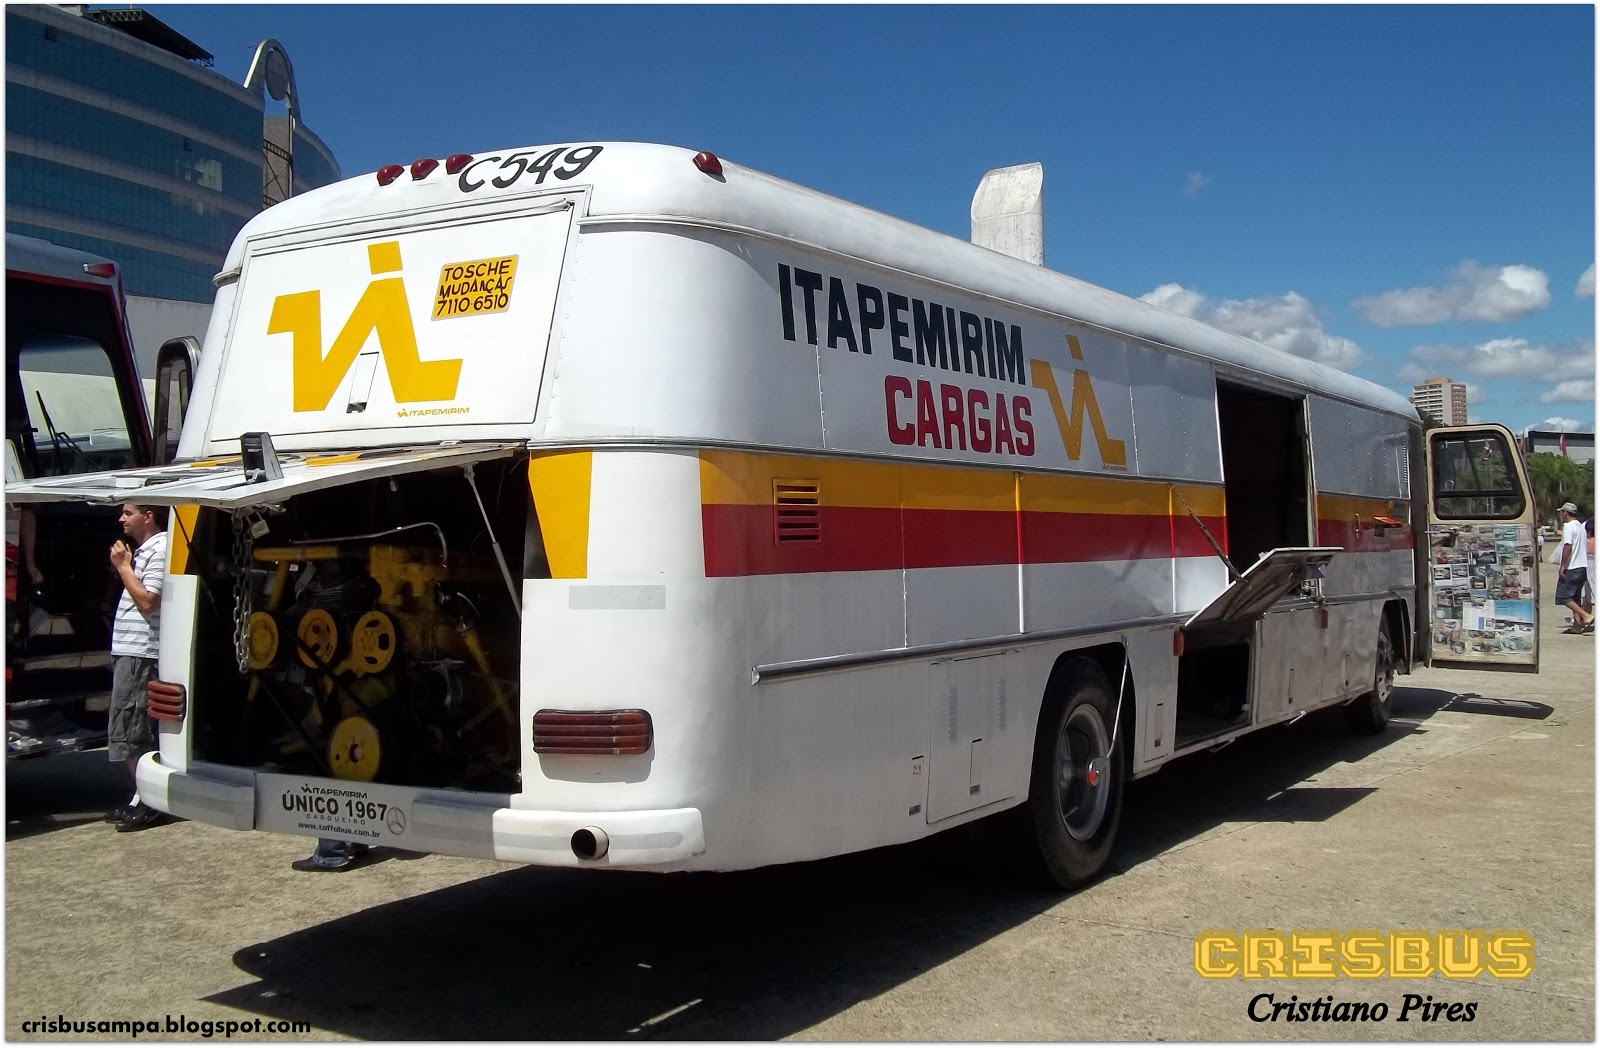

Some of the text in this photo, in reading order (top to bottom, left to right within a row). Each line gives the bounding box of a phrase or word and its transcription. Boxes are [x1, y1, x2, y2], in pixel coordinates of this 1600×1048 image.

[458, 145, 604, 193] C549
[444, 259, 513, 282] TOSCHE
[440, 275, 513, 299] MUDANÇAS
[777, 262, 1026, 386] ITAPEMIRIM
[409, 407, 470, 417] ITAPEMIRIM
[884, 374, 1035, 457] CARGAS
[312, 787, 368, 800] ITAPEMIRIM
[282, 790, 388, 822] ÚNICO 1967
[306, 813, 366, 826] CARGUEIRO
